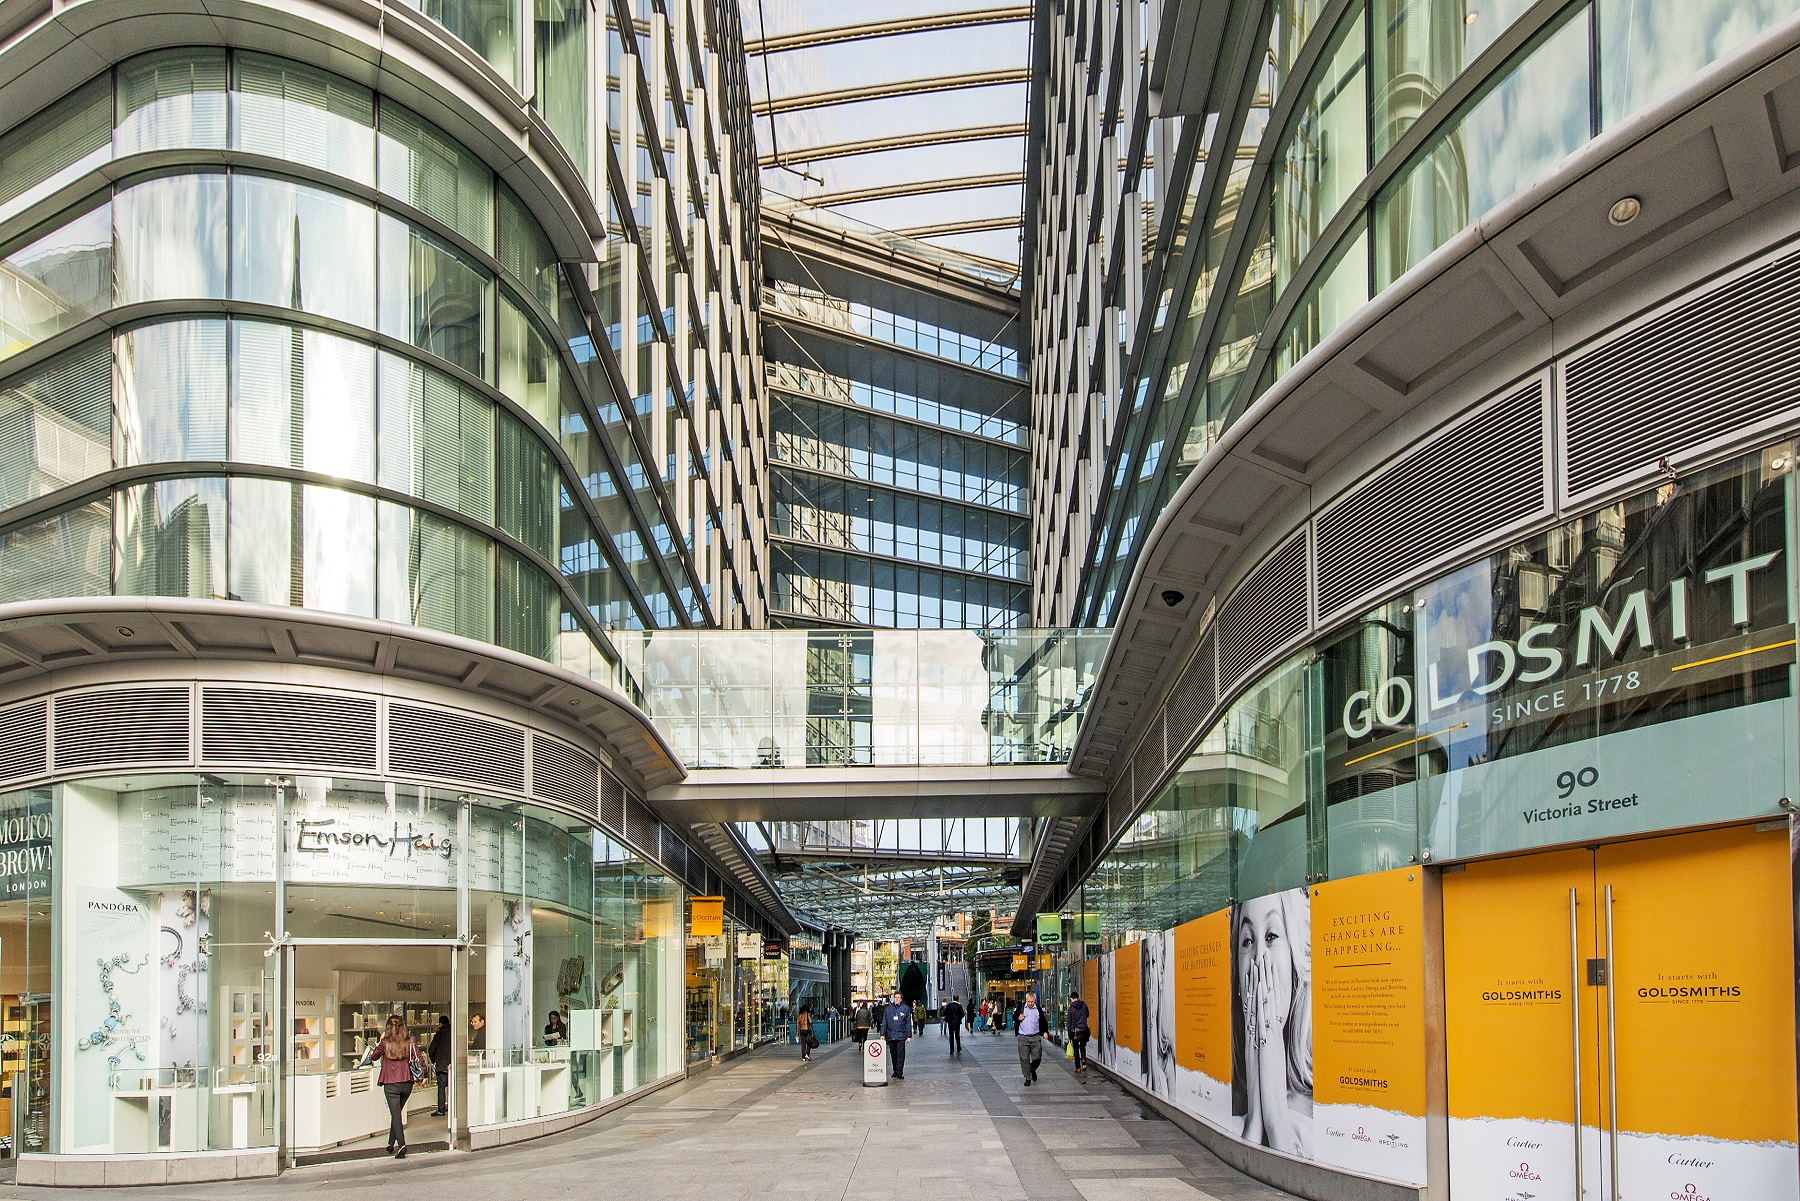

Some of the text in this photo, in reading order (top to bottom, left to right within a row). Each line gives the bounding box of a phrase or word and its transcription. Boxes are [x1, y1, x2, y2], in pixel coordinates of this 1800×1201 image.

[1492, 671, 1642, 724] SINCE 1778
[1556, 766, 1599, 799] 90
[1522, 792, 1639, 824] Victoria Street
[296, 819, 388, 853] Emson
[389, 822, 451, 859] Haig
[6, 880, 46, 892] LONDON
[1333, 911, 1390, 926] EXCITING
[1323, 925, 1404, 942] CHANGES ARE
[1326, 942, 1400, 956] HAPPENING...
[1482, 990, 1561, 1000] GOLDSMITHS
[1638, 986, 1741, 997] GOLDSMITHS
[257, 1053, 278, 1062] 92a
[1340, 1076, 1388, 1088] GOLDSMITHS
[1326, 1127, 1408, 1148] Cartier OMEGA BREITLING
[1507, 1136, 1542, 1149] Cartier
[1668, 1153, 1714, 1168] Cartier
[1509, 1170, 1541, 1181] OMEGA
